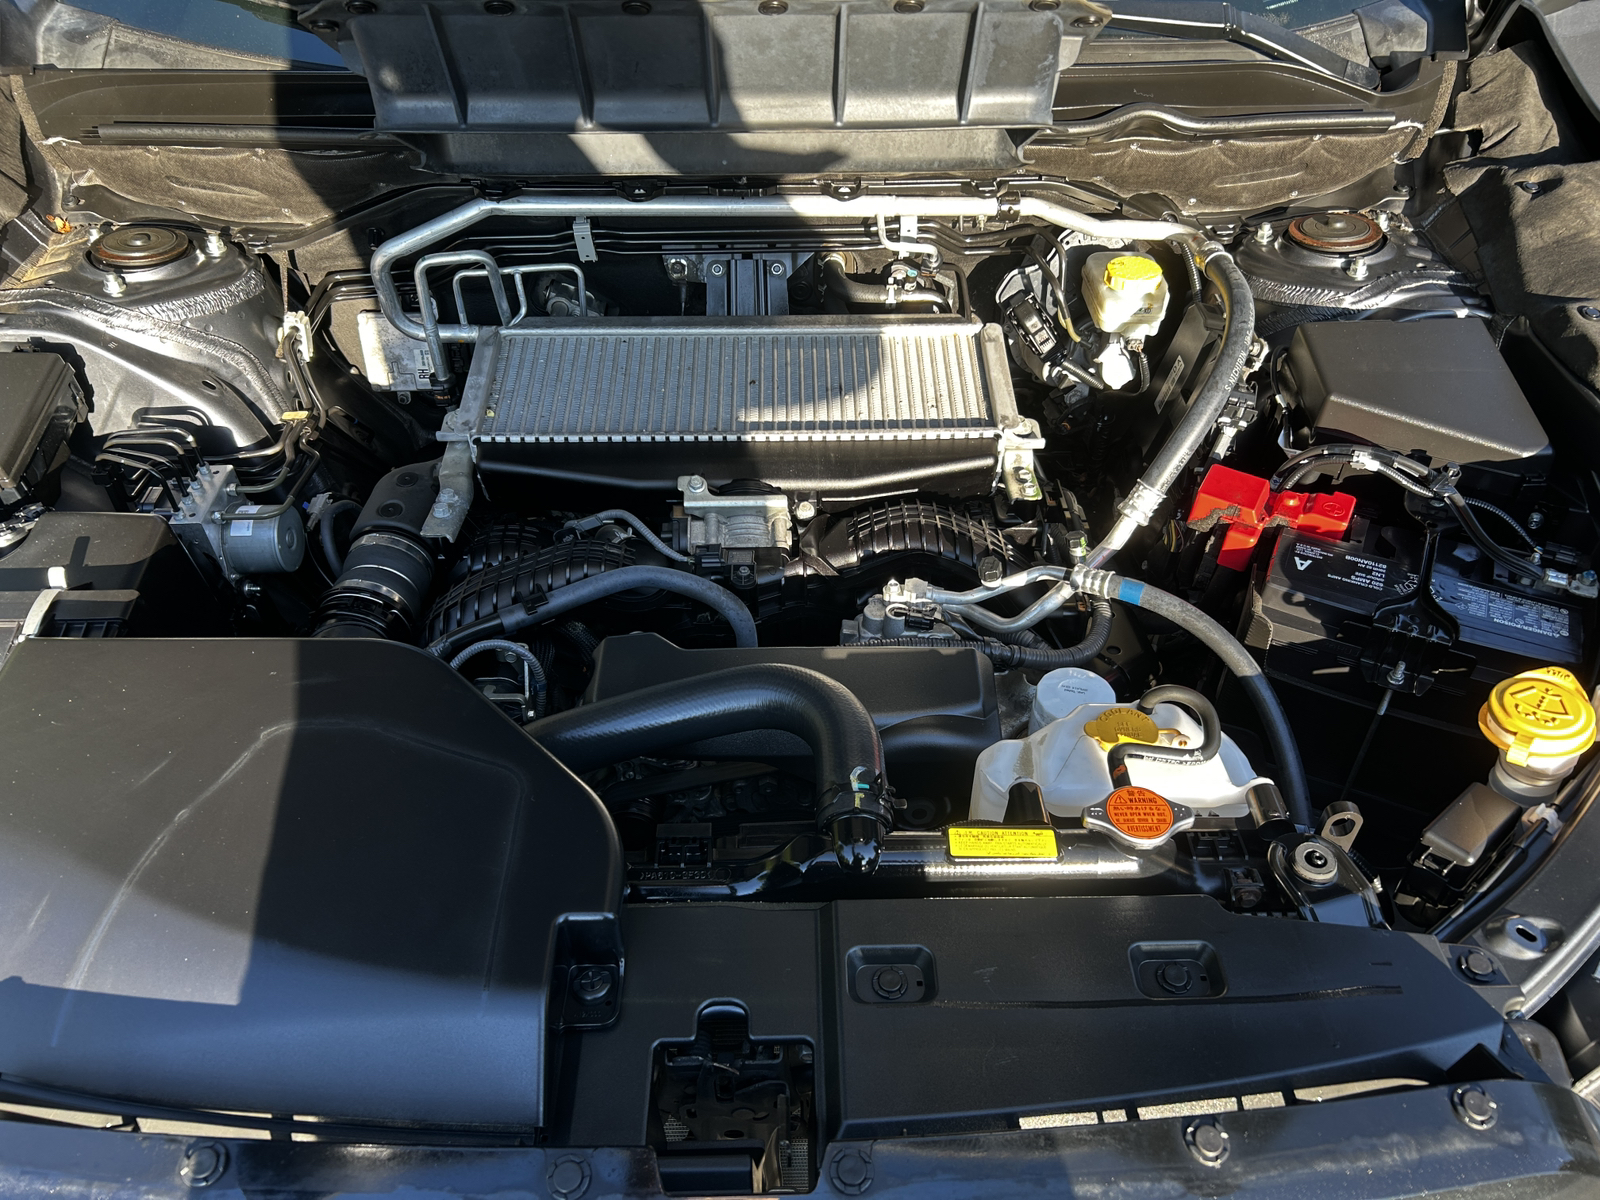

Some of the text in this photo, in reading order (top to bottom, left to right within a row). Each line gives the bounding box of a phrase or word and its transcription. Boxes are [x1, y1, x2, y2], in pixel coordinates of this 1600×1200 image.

[417, 369, 429, 379] RH
[1294, 556, 1312, 571] A
[1341, 577, 1368, 587] CRANKING
[1350, 574, 1370, 583] AMPS
[1099, 708, 1150, 722] COOLANT
